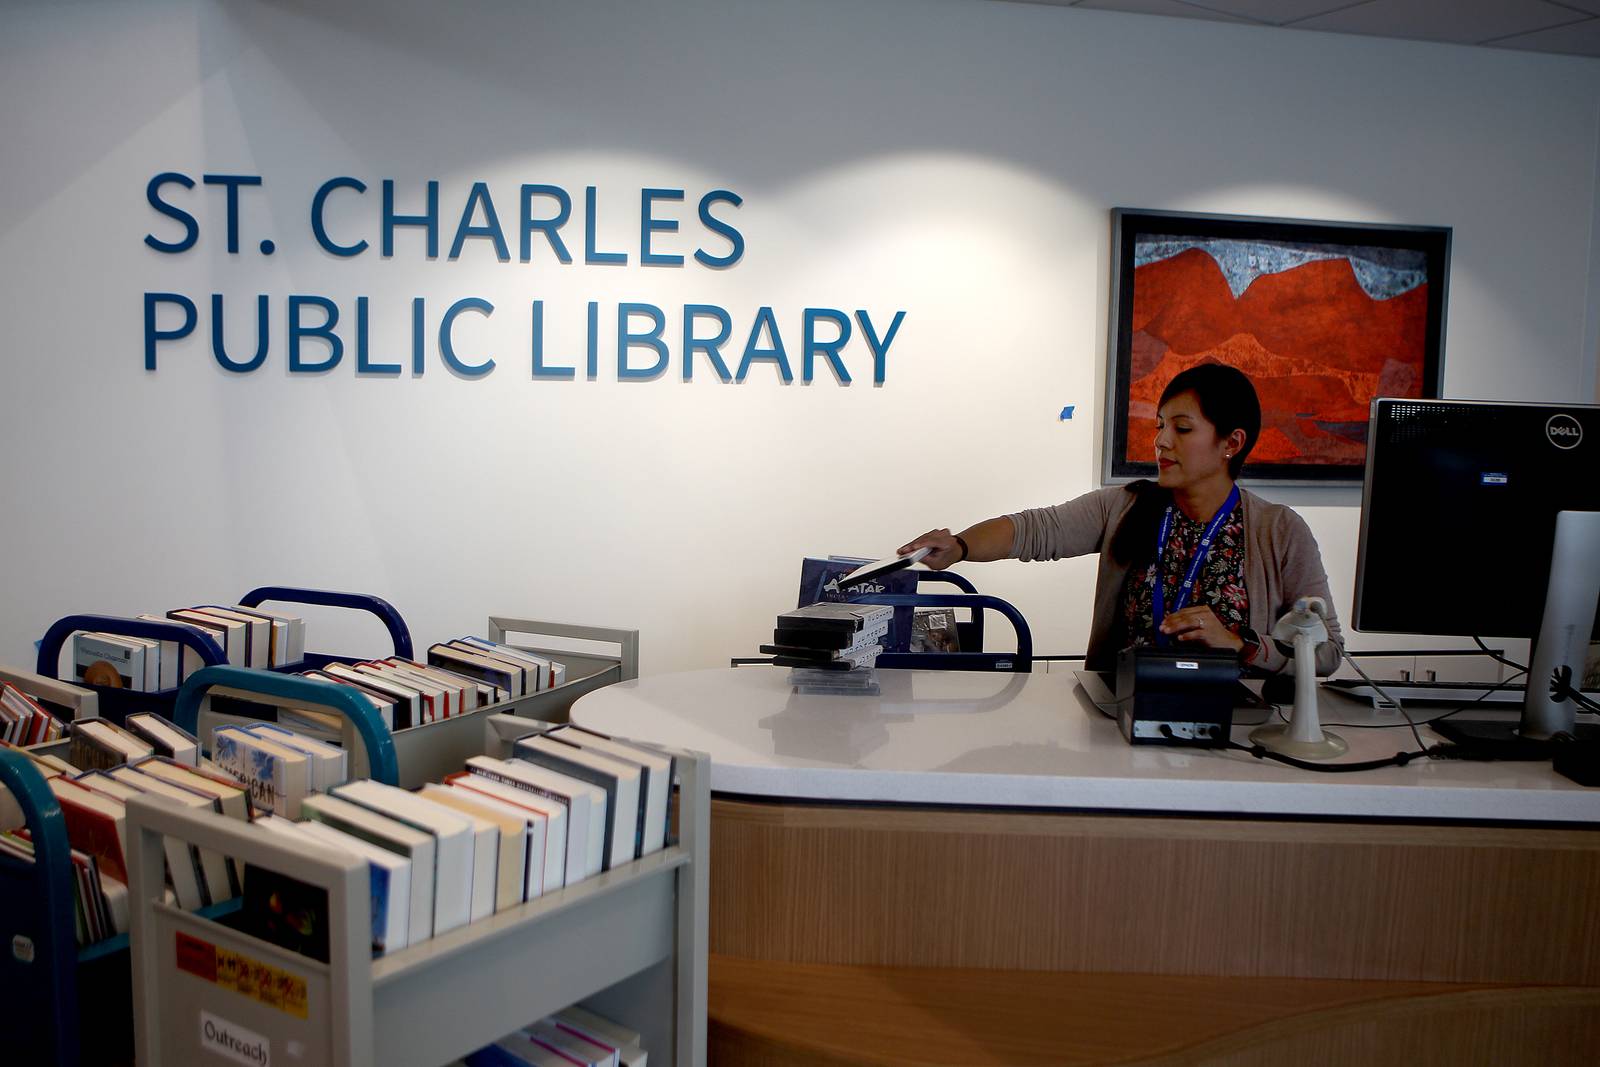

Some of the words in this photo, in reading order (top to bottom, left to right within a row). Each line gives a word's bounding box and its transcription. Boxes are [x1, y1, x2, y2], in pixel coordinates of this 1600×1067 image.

[143, 172, 276, 256] ST.
[311, 177, 746, 270] CHARLES
[143, 292, 496, 379] PUBLIC
[531, 300, 907, 387] LIBRARY
[1549, 426, 1579, 436] DELL
[824, 578, 885, 593] AATAR
[204, 1020, 267, 1066] Outreach
